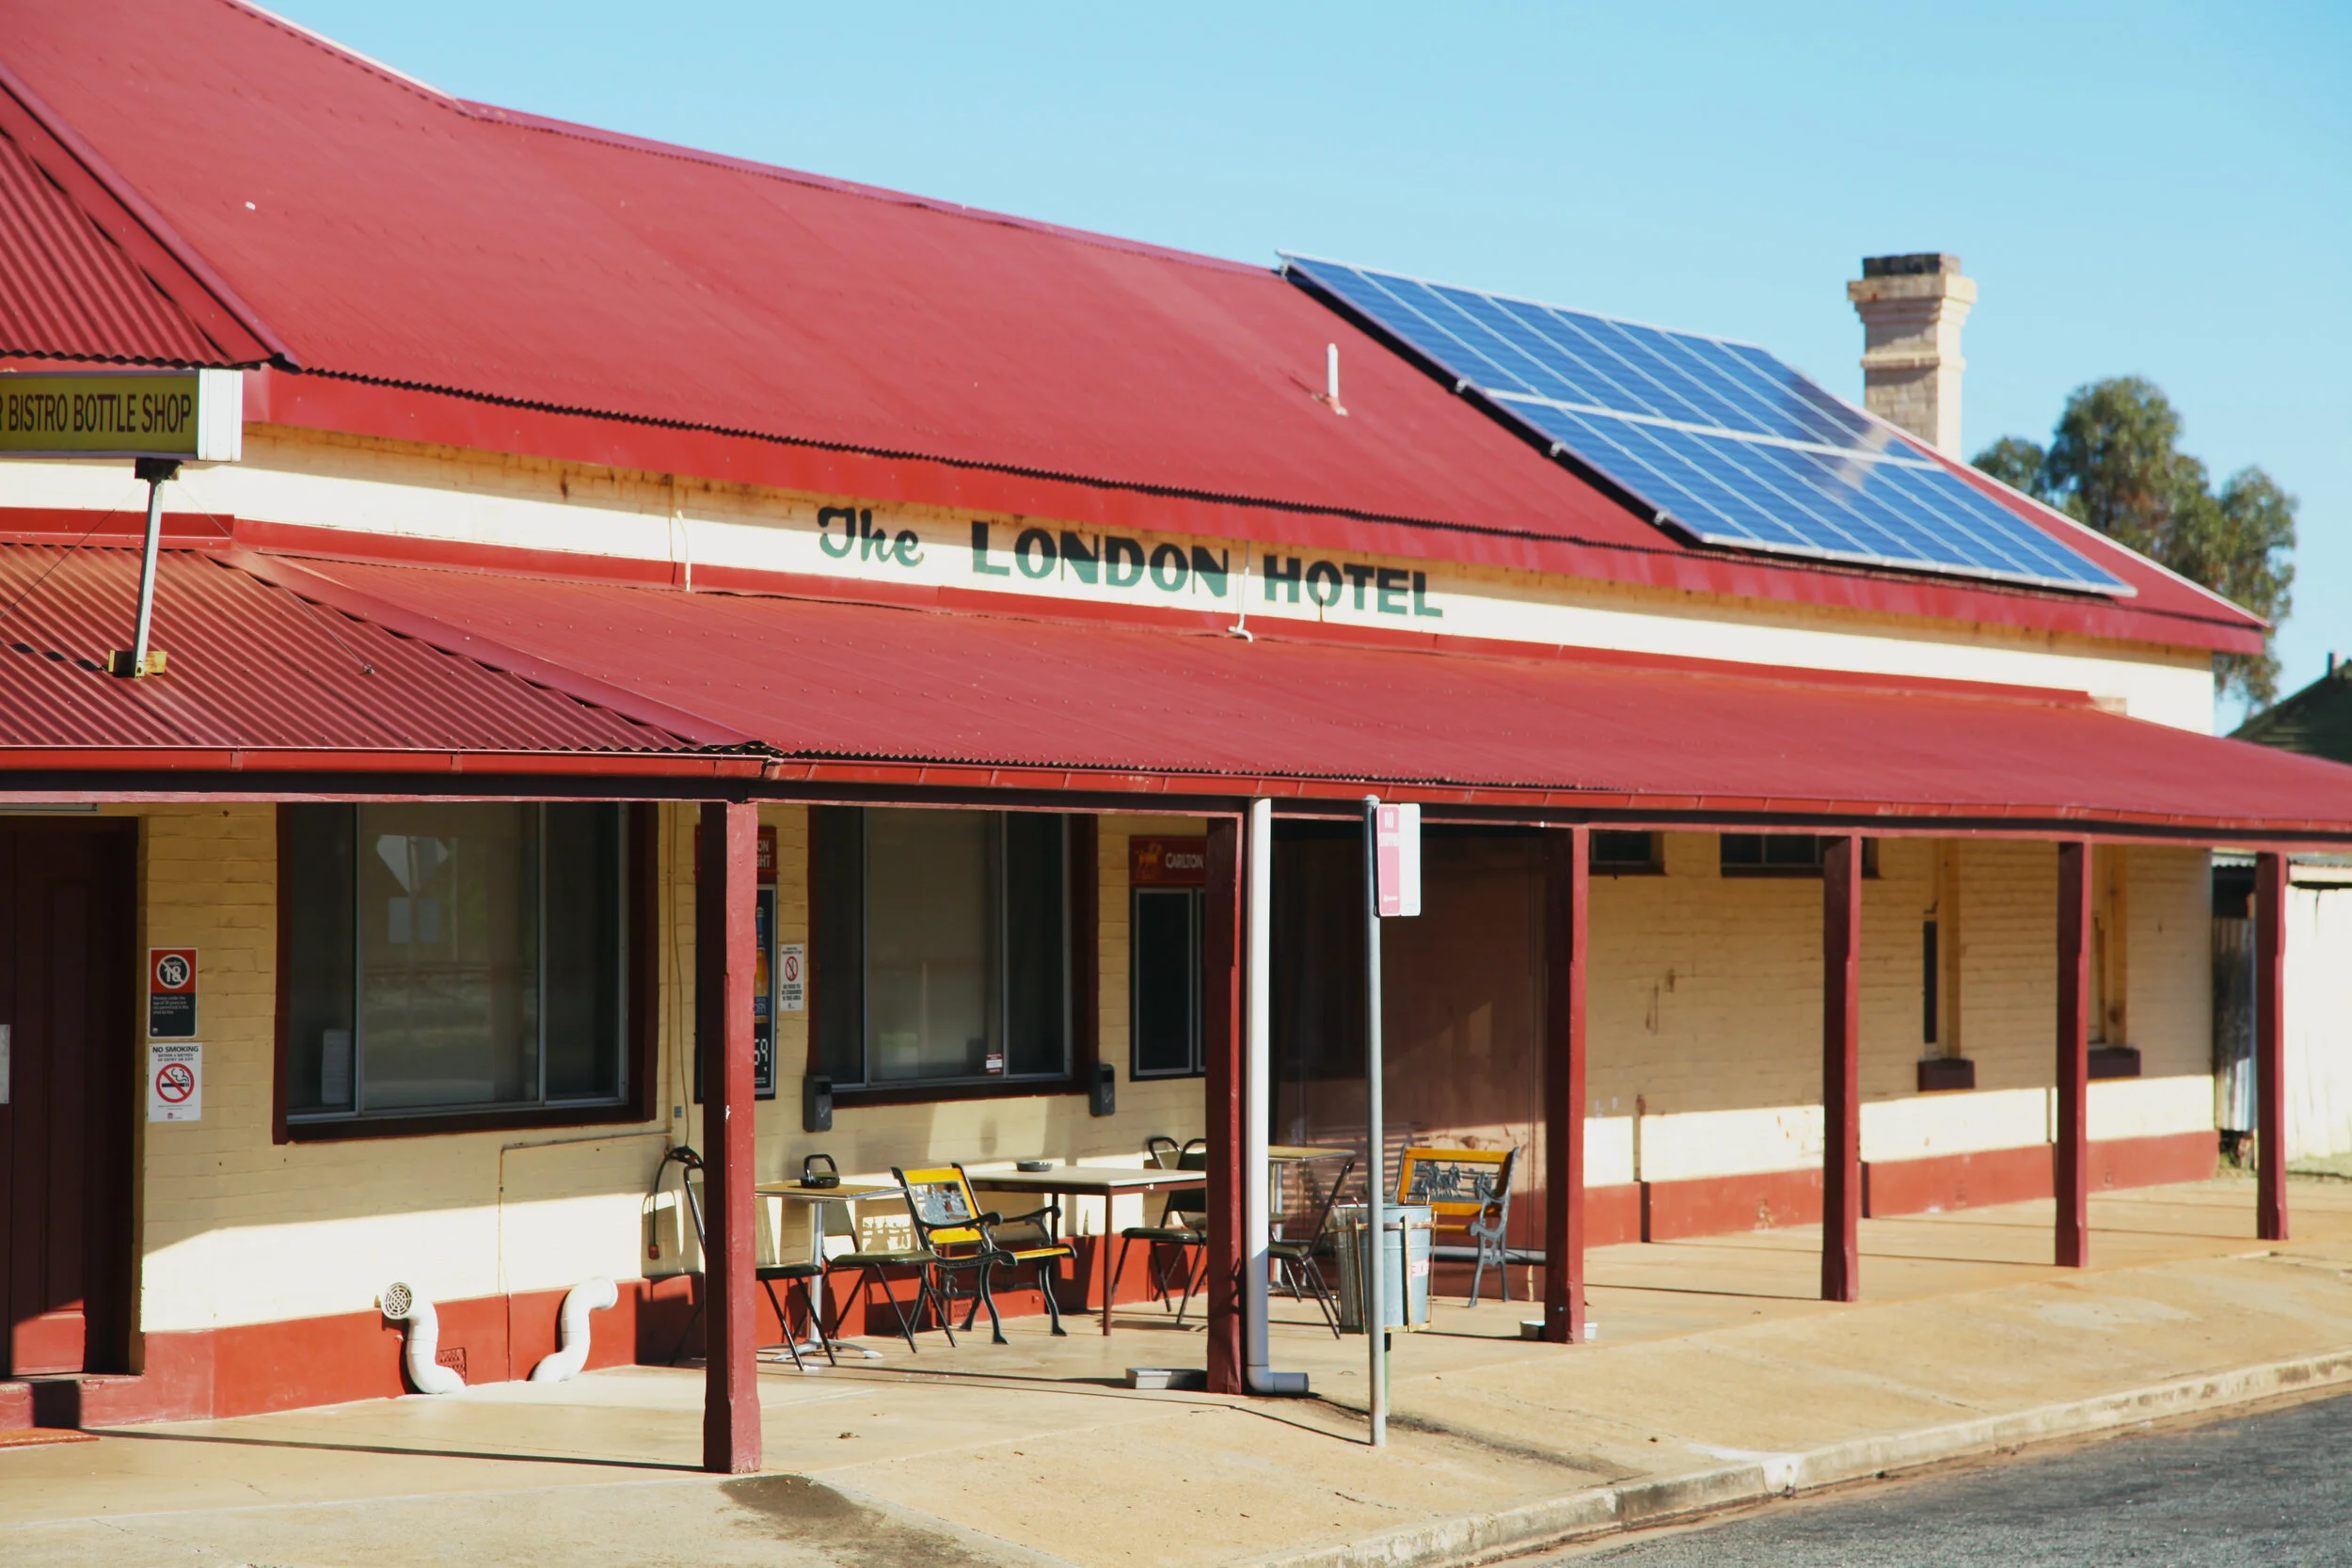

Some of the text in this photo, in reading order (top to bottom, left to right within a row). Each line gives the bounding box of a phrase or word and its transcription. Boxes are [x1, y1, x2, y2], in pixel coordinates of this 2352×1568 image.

[8, 393, 68, 432] BISTRO
[72, 393, 136, 433] BOTTLE
[141, 393, 192, 433] SHOP
[817, 505, 1444, 618] The LONDON HOTEL
[1165, 852, 1204, 869] CARLTON
[164, 965, 182, 983] 18
